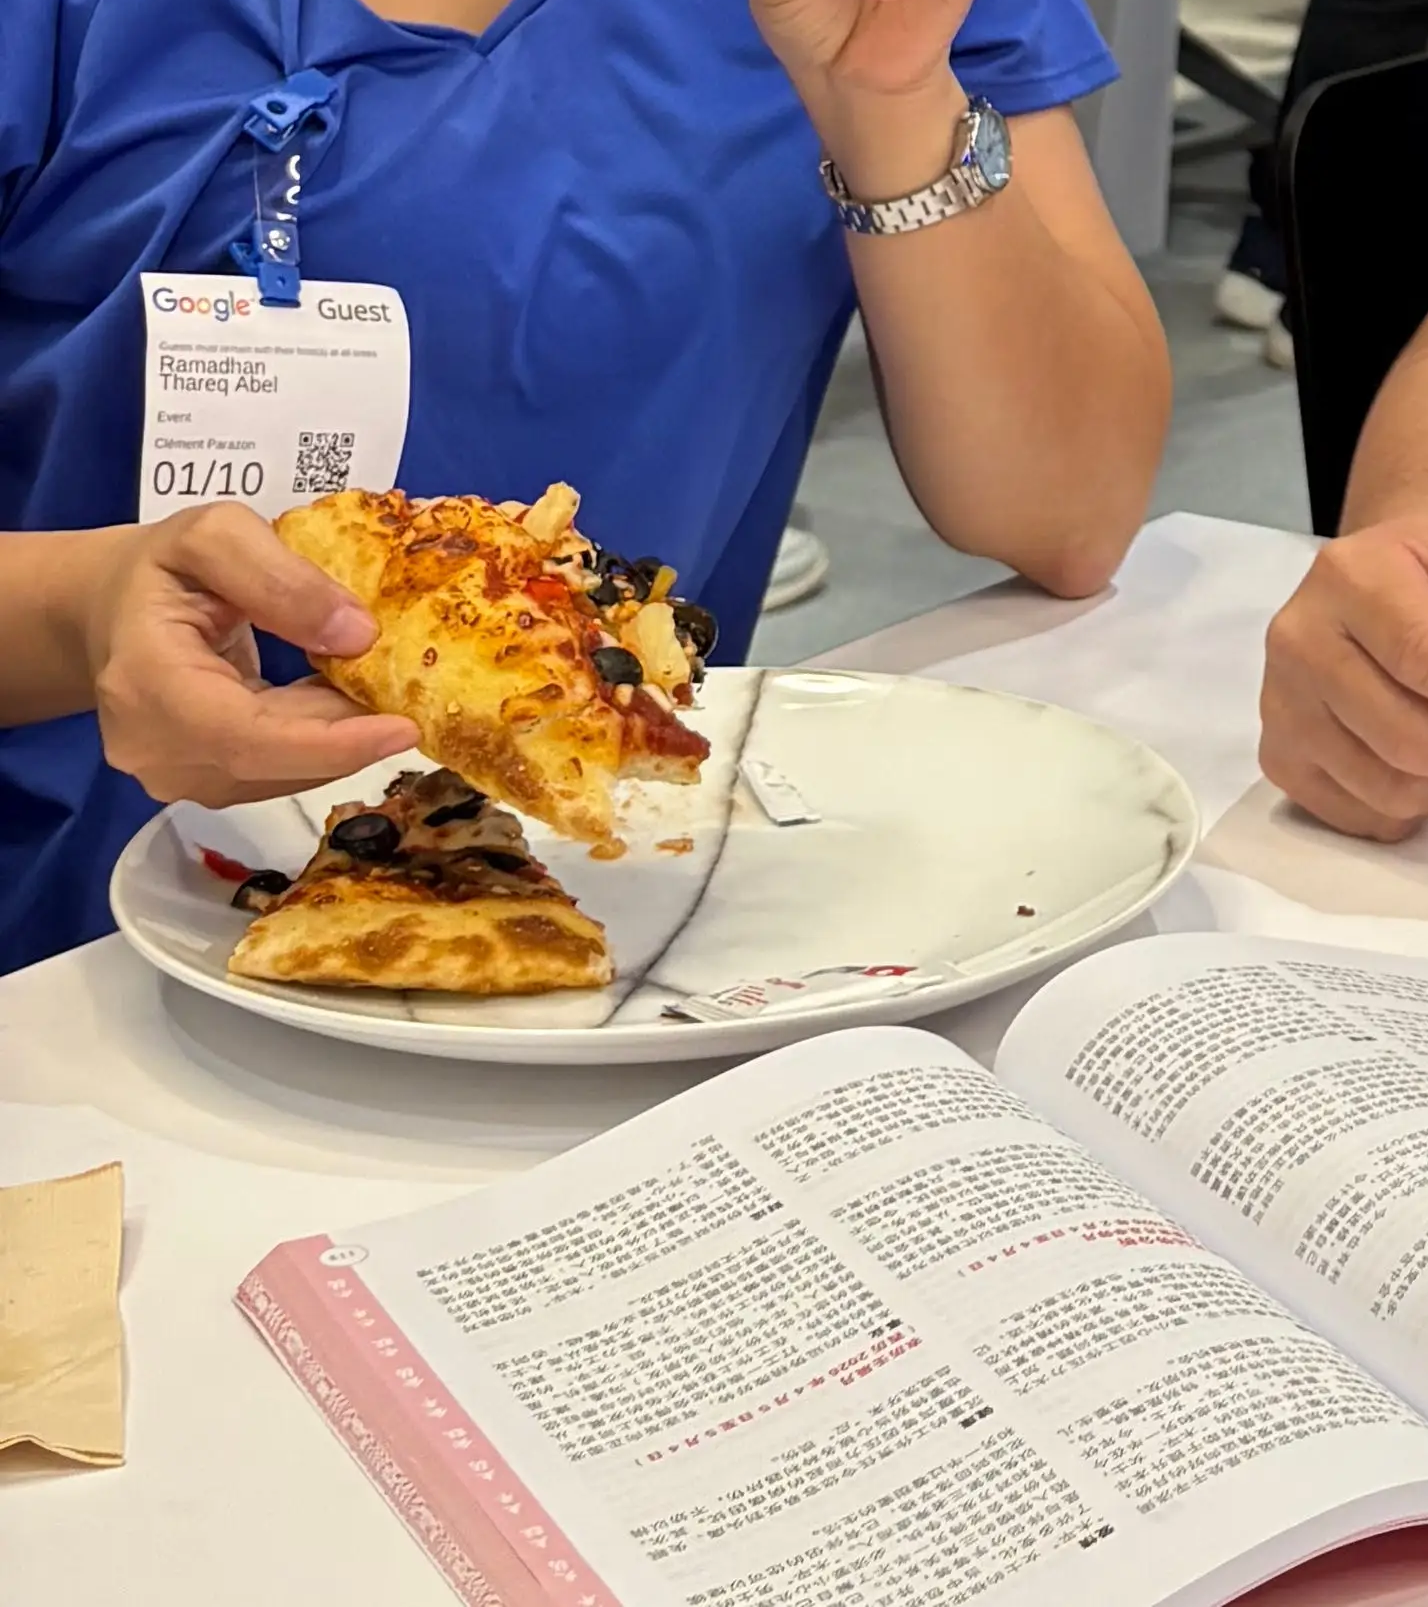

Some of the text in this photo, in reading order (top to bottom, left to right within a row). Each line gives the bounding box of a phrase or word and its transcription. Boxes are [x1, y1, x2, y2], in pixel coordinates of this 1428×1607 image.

[152, 287, 392, 323] Google Guest
[159, 355, 267, 376] Ramadhan
[159, 372, 279, 397] Thareq Abel
[157, 410, 193, 424] Event
[152, 459, 265, 497] 01/10
